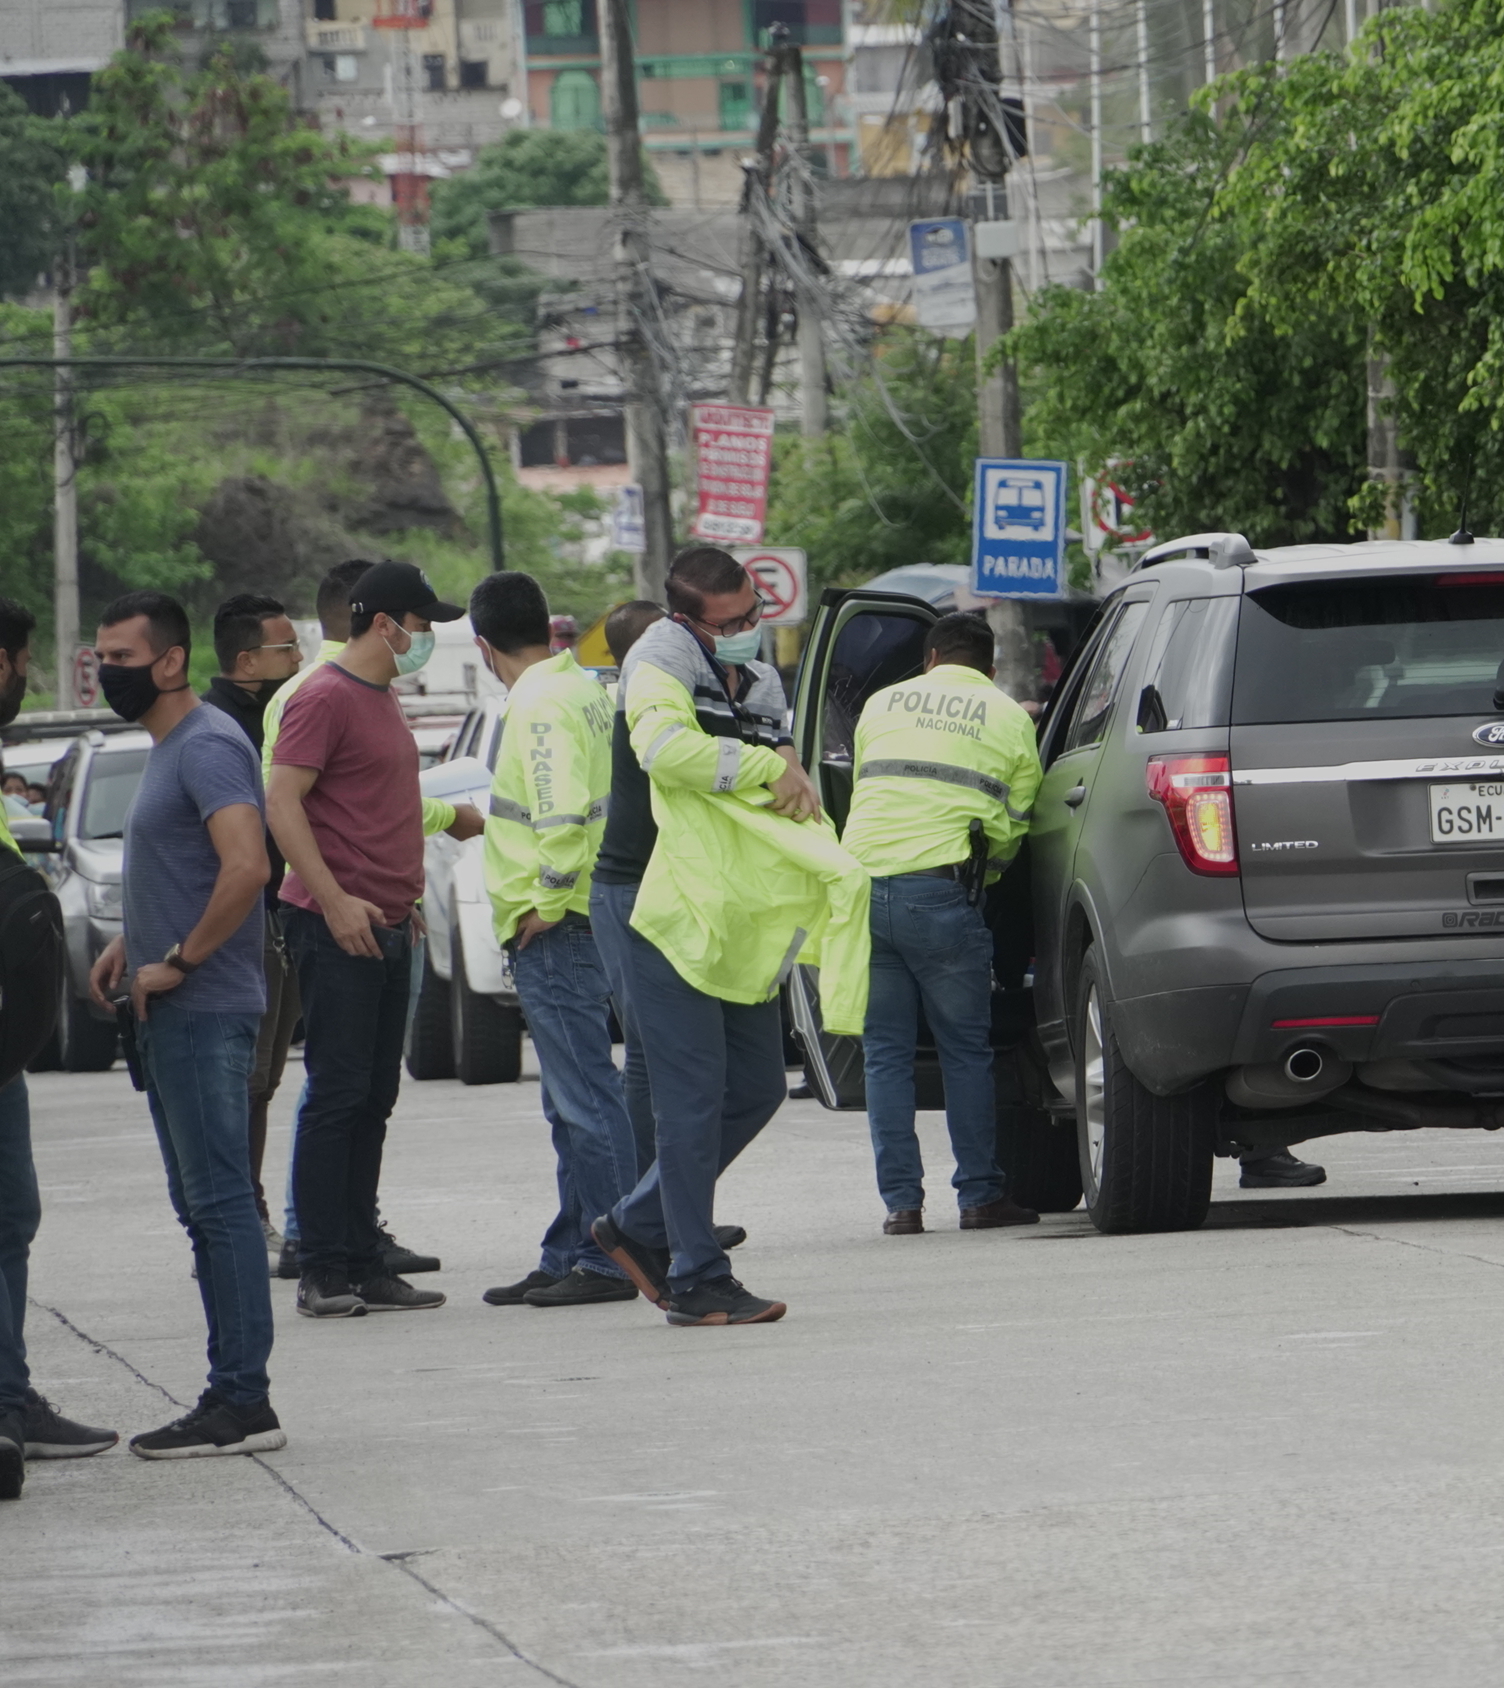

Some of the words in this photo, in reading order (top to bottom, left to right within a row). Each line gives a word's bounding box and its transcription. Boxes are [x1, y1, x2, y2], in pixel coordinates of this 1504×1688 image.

[983, 555, 1056, 579] PARADA
[887, 691, 987, 726] POLICÍA
[915, 716, 982, 741] NACIONAL
[530, 722, 555, 815] DINASED
[1251, 840, 1319, 852] LIMITED
